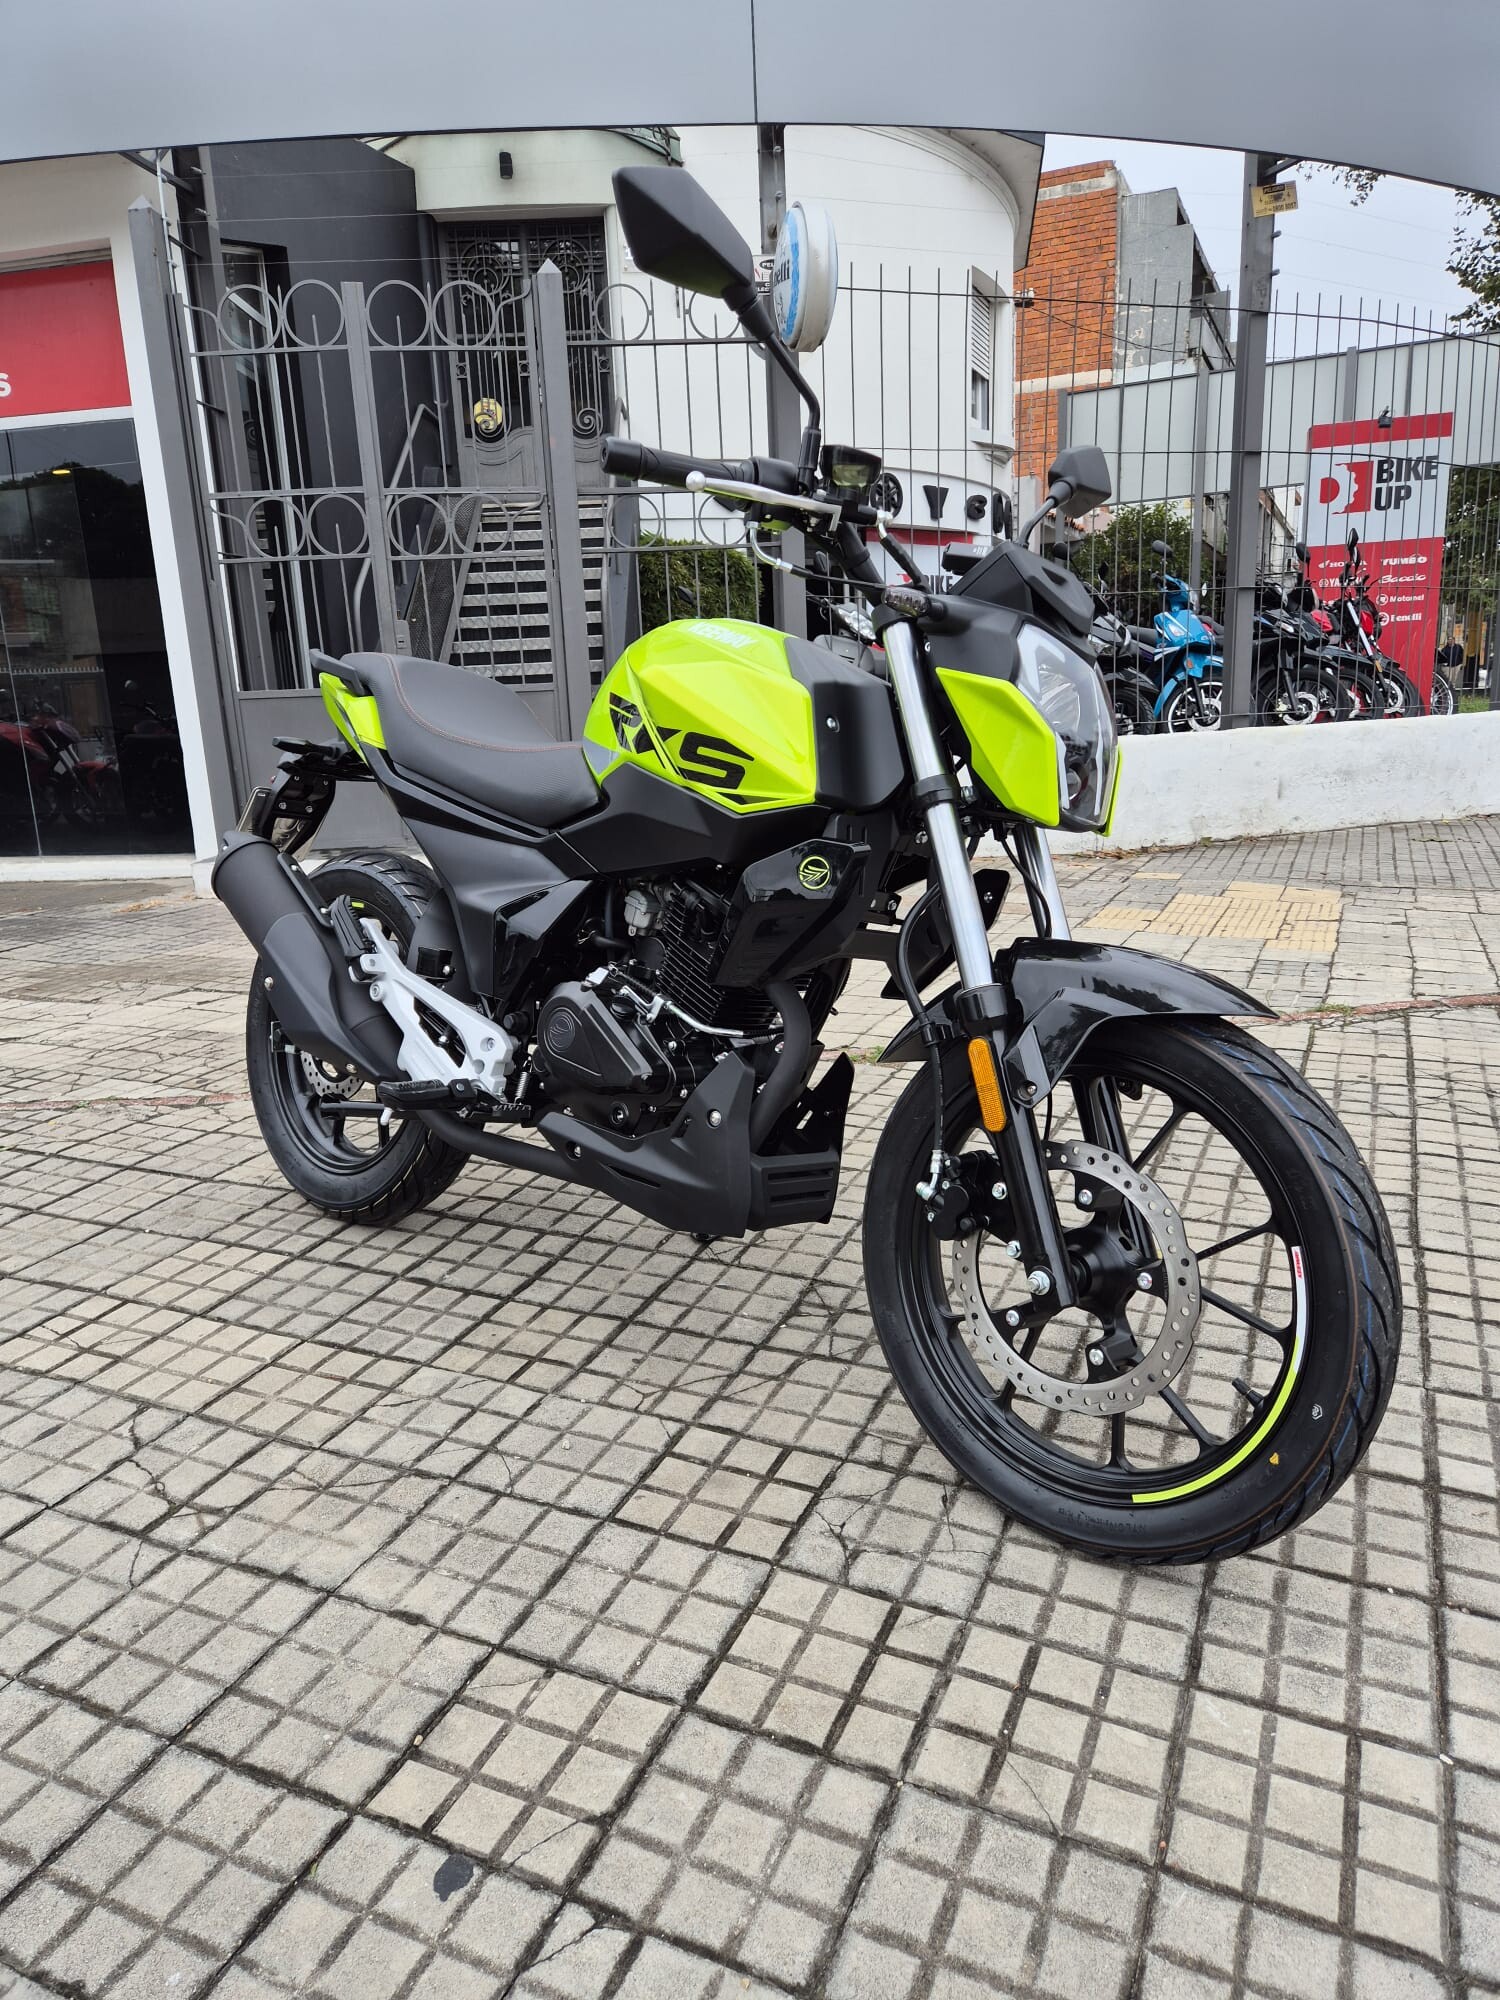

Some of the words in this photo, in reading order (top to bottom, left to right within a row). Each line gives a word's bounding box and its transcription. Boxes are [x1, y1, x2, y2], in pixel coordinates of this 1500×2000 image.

[1376, 455, 1439, 484] BIKE
[1374, 484, 1412, 511] UP
[609, 691, 755, 790] RKS
